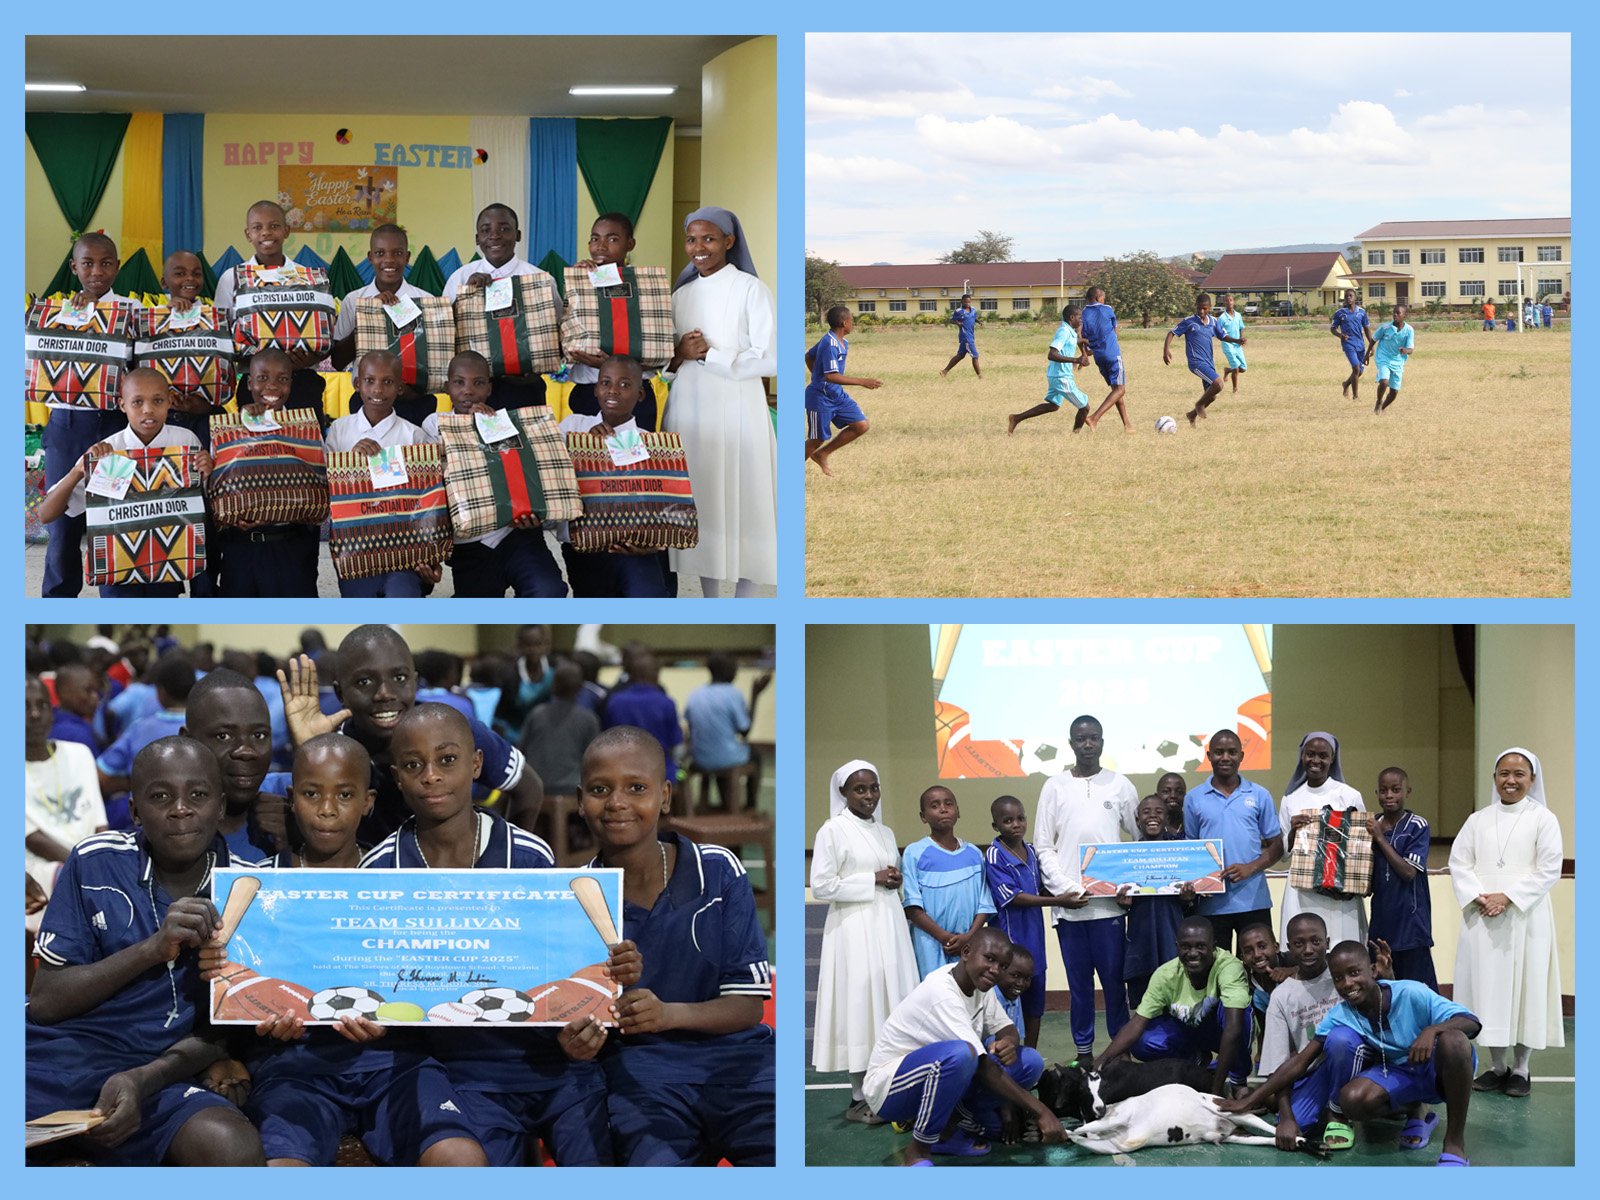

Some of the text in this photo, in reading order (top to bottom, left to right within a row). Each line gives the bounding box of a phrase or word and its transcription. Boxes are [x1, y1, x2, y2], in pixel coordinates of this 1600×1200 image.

[224, 142, 472, 169] HAPPY EASTER
[309, 176, 351, 193] Happy
[305, 191, 354, 206] Easter
[252, 291, 316, 304] CHRISTIAN DIOR
[37, 338, 108, 353] CHRISTIAN DIOR
[152, 338, 218, 351] CHRISTIAN DIOR
[601, 479, 664, 493] CHRISTIAN DIOR
[108, 500, 189, 521] CHRISTIAN DIOR
[981, 636, 1224, 667] EASTER CUP
[256, 890, 575, 900] EASTER CUP CERTIFICATE
[437, 905, 486, 913] presented
[331, 917, 520, 929] TEAM SULLIVAN
[362, 938, 490, 950] CHAMPION
[333, 955, 372, 963] during
[547, 996, 593, 1021] OOTBALL
